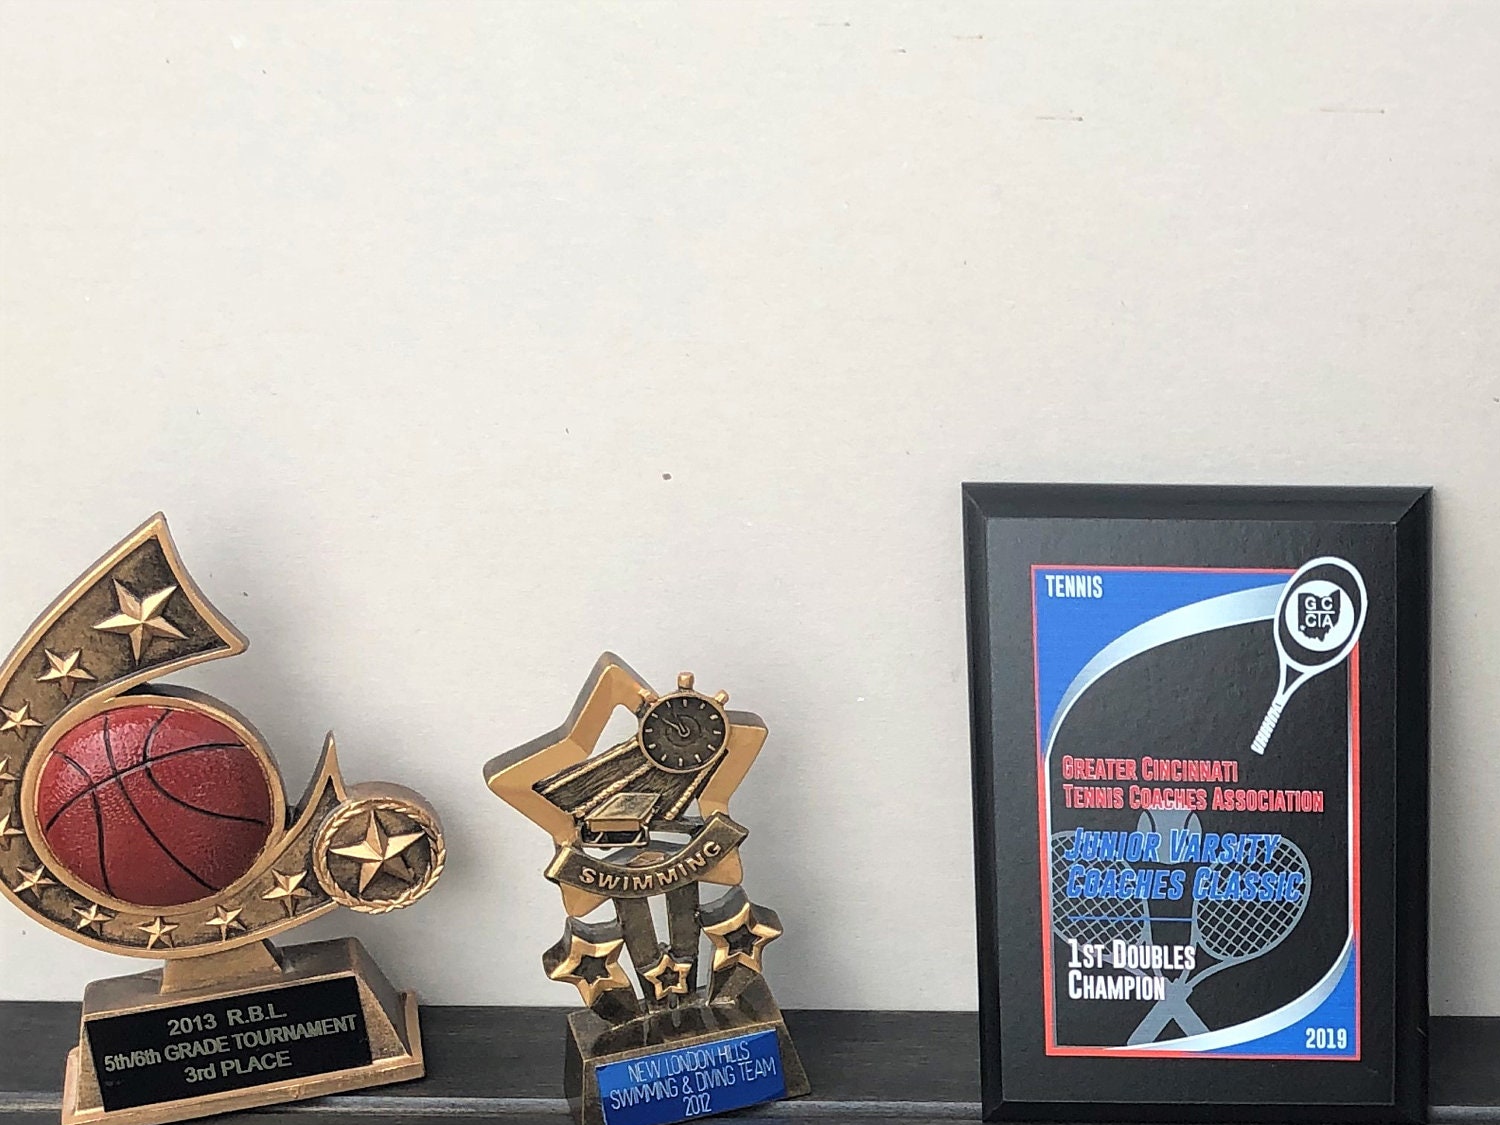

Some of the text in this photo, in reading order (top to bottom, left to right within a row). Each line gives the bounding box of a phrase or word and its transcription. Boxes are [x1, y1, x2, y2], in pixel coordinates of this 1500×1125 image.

[1045, 574, 1103, 599] TENNIS
[1062, 755, 1239, 783] GREATER CINCINNATI
[1062, 784, 1324, 814] TENNIS COACHES ASSOCIATION
[1065, 827, 1281, 864] JUNIOR VARSITY
[580, 840, 723, 891] SWIMMING
[1066, 865, 1305, 902] COACHES CLASSIC
[1068, 938, 1196, 971] 1ST DOUBLES
[1068, 970, 1165, 1000] CHAMPION
[168, 1003, 288, 1037] 2013 R.B.L.
[105, 1014, 358, 1073] 5th/6th GRADE TOURNAMENT
[1305, 1028, 1347, 1049] 2019
[184, 1051, 292, 1084] 3rd PLACE
[628, 1041, 750, 1081] NEW LONDON HILLS
[610, 1078, 678, 1110] SWIMMING
[682, 1075, 693, 1094] &
[739, 1057, 776, 1081] TEAM
[683, 1094, 712, 1117] 2012
